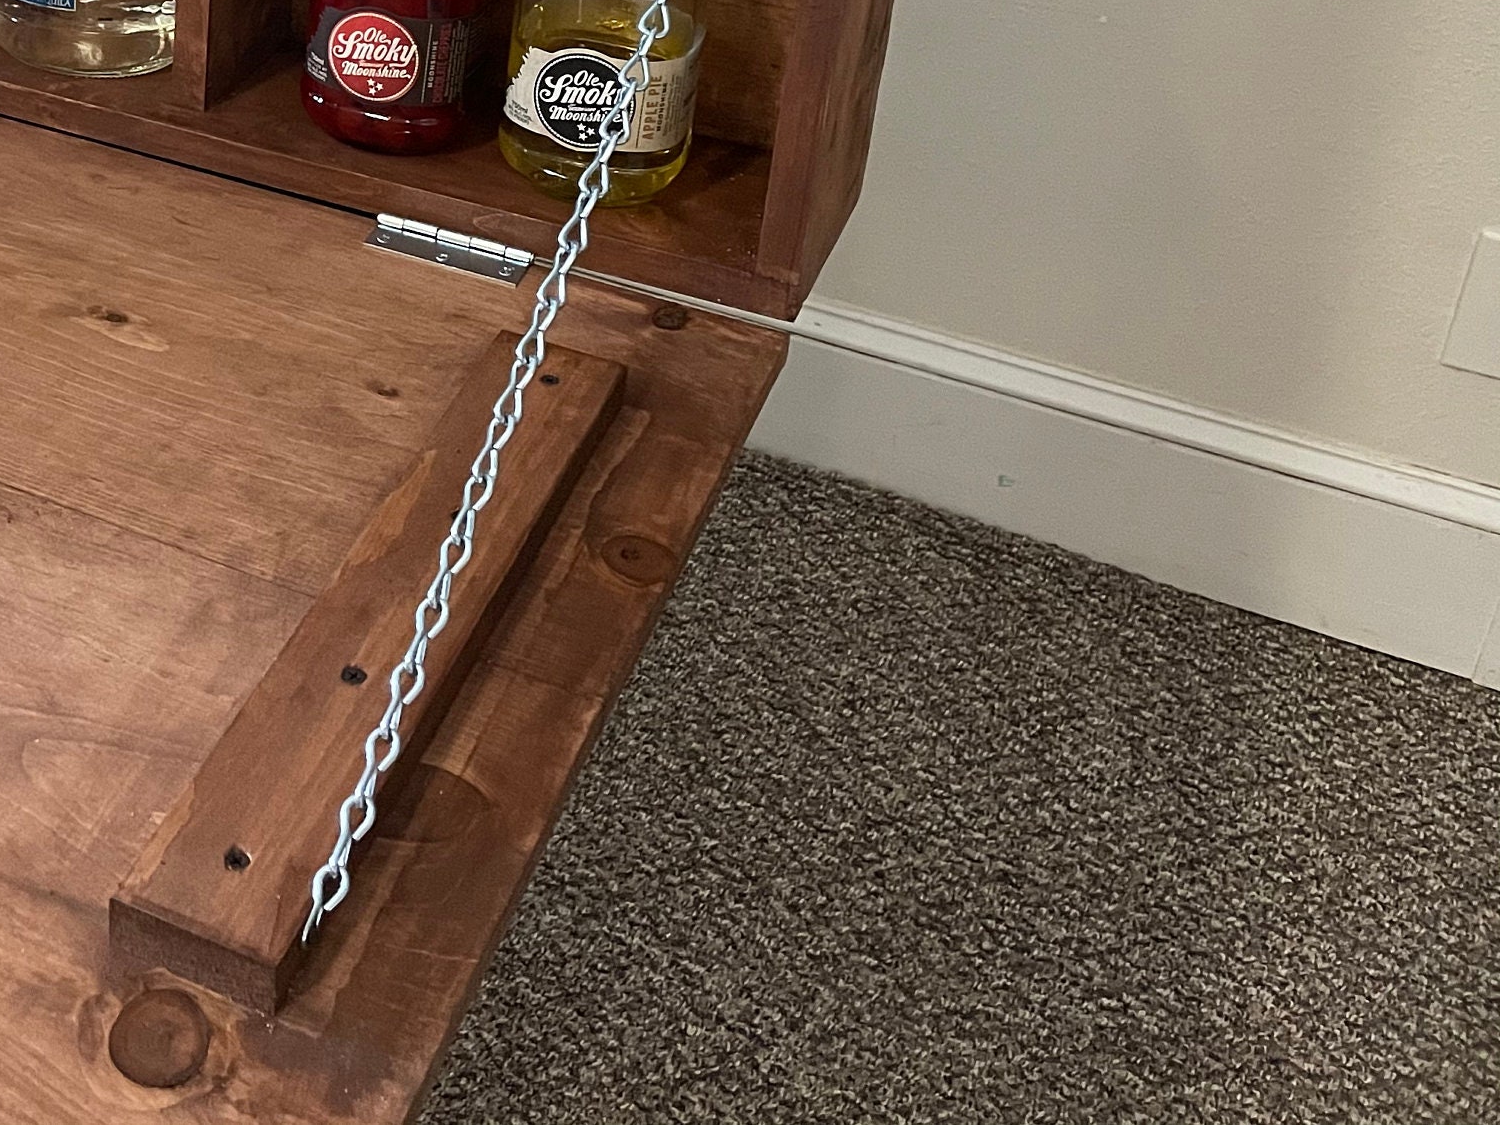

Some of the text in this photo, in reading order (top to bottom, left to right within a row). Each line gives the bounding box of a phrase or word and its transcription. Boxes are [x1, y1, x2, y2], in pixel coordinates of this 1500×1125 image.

[332, 30, 418, 67] Smoky
[364, 27, 392, 44] Ole
[341, 60, 412, 80] Moonshine
[427, 40, 438, 88] MOONSHINE
[573, 70, 604, 88] Ole
[539, 74, 620, 110] Smok
[642, 75, 662, 140] APPLE PIE
[656, 82, 668, 132] MOONSHINE
